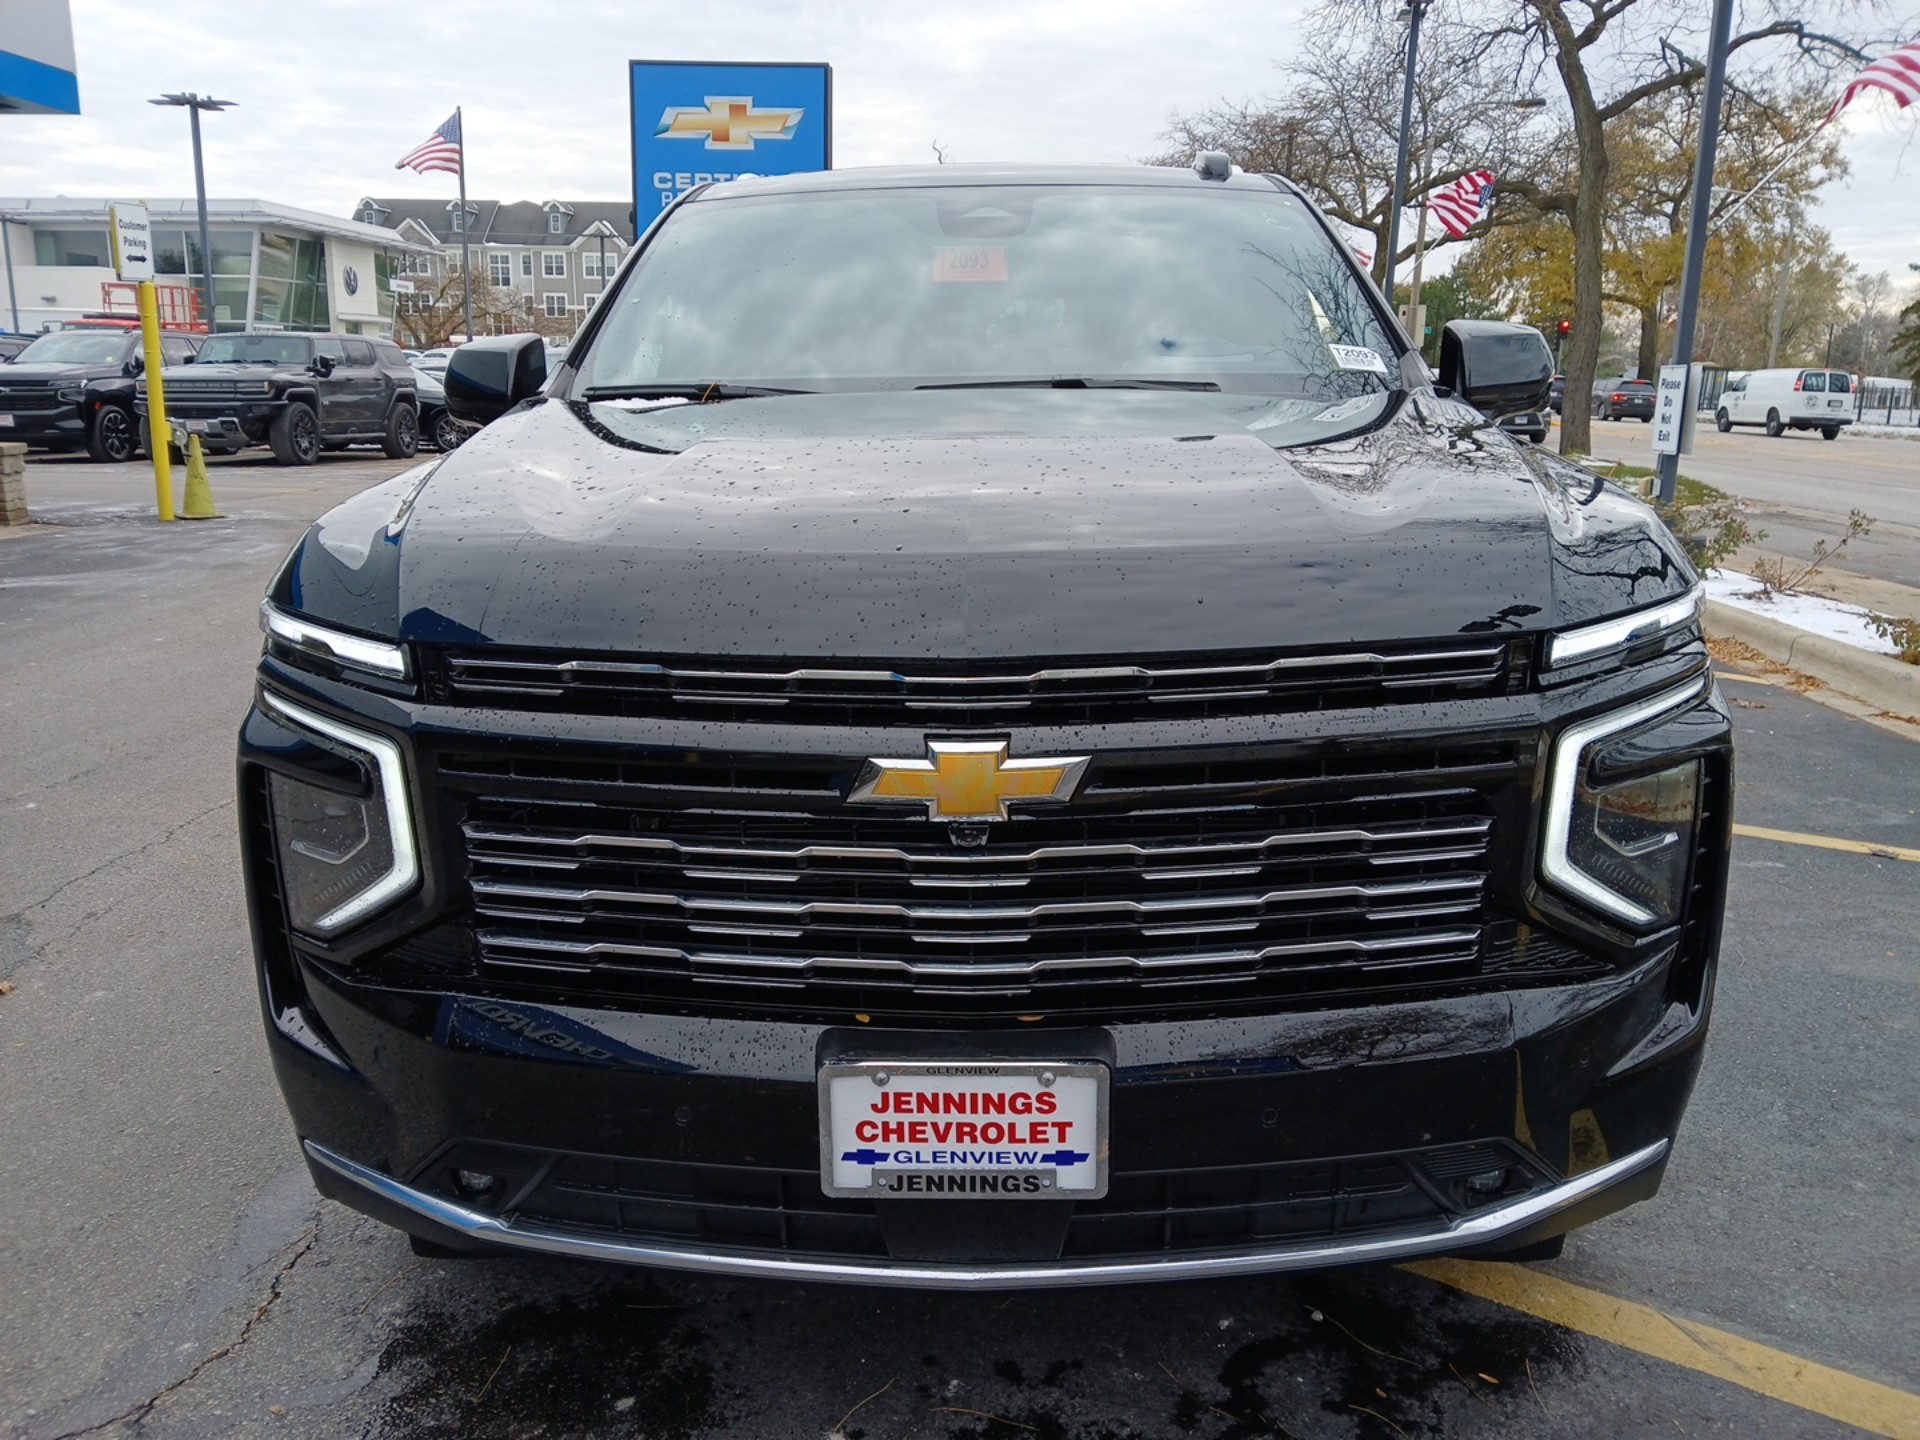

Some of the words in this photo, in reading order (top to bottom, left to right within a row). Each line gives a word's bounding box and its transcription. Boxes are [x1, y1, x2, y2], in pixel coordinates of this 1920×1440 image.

[118, 218, 148, 232] Customer
[123, 235, 148, 251] Parking
[948, 250, 990, 270] 2093
[1661, 377, 1682, 391] Please
[1663, 394, 1674, 408] Do
[1660, 413, 1673, 425] Not
[1657, 429, 1671, 442] Exit
[926, 1066, 1000, 1075] GLENVIEW
[870, 1091, 1058, 1115] JENNINGS
[855, 1120, 1074, 1145] CHEVROLET
[893, 1150, 1039, 1165] GLENVIEW
[888, 1175, 1041, 1193] JENNINGS
